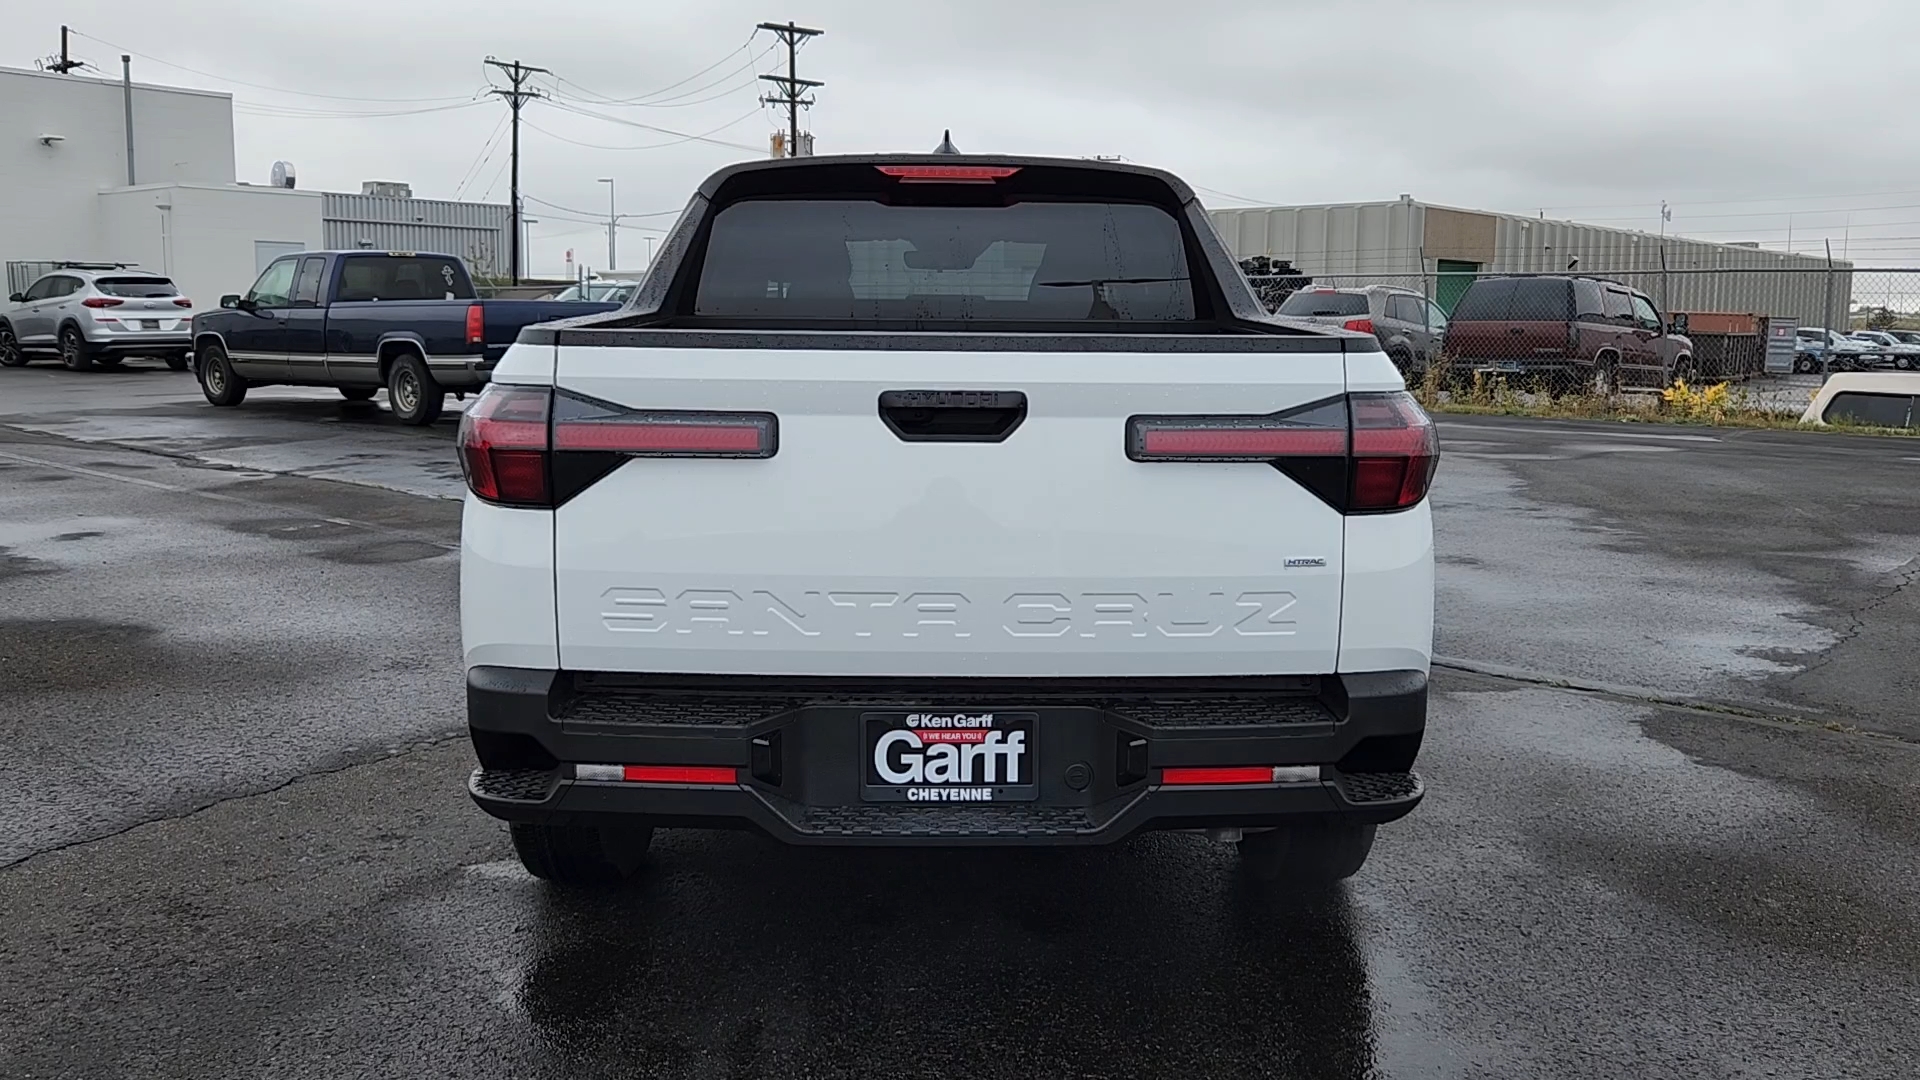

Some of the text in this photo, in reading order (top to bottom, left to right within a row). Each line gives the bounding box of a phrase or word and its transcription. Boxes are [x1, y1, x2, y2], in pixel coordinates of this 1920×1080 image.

[1287, 558, 1325, 566] HTRAC
[600, 587, 1297, 638] SANTA CRUZ
[920, 713, 993, 728] Ken Garff
[928, 732, 977, 740] WE HEAR YOU
[874, 730, 1025, 784] Garff
[907, 788, 993, 801] CHEYENNE
